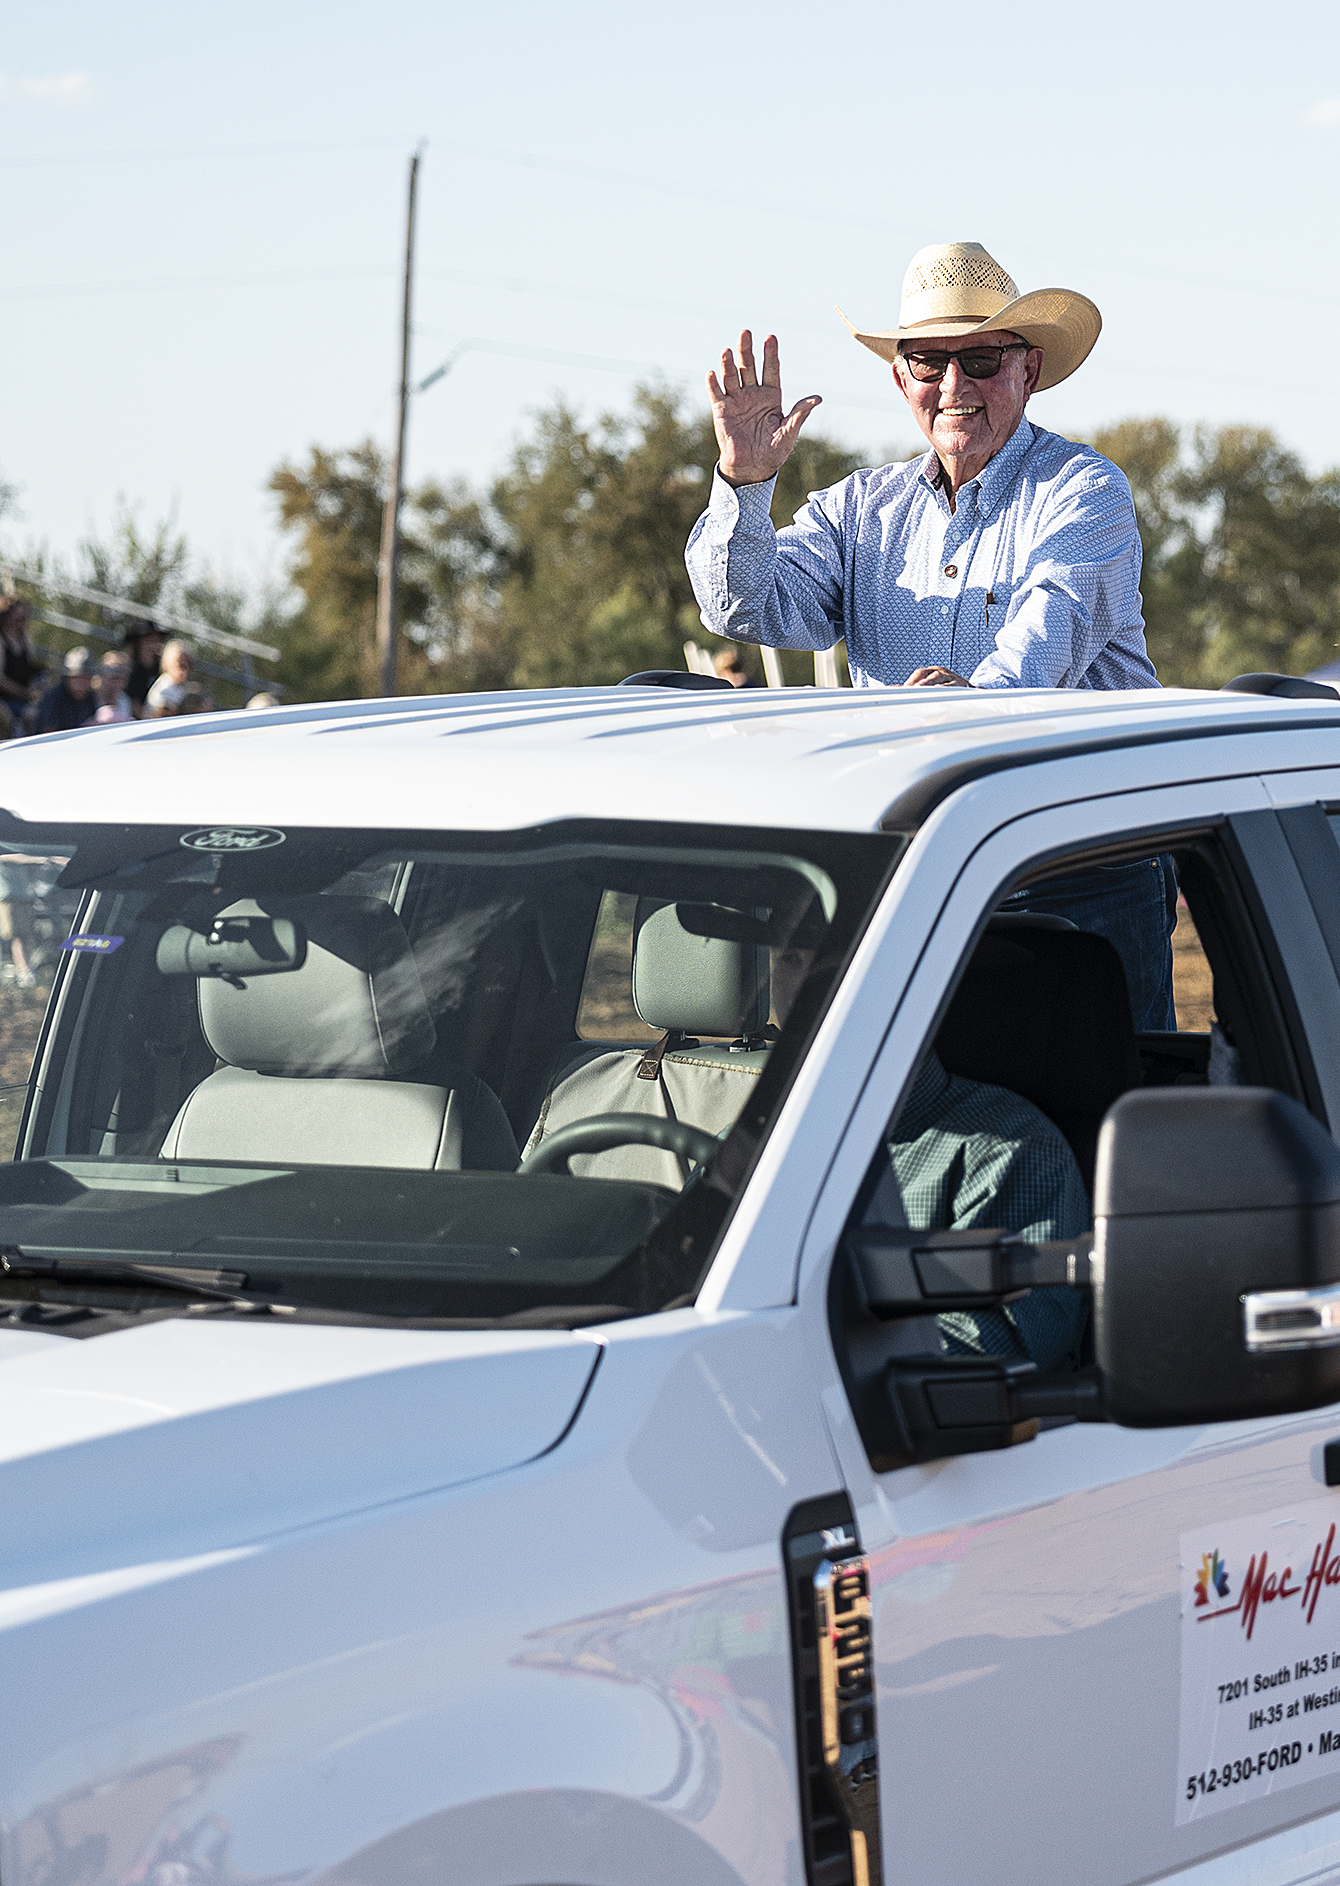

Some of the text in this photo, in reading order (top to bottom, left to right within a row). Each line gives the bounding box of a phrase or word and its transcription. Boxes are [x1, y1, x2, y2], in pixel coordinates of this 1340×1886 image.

[194, 828, 270, 848] Ford
[1197, 1551, 1301, 1640] Mac
[1217, 1677, 1248, 1704] 7201
[1254, 1666, 1291, 1695] South
[1295, 1654, 1328, 1680] IH-35
[1248, 1703, 1283, 1731] IH-35
[1286, 1700, 1300, 1719] at
[1186, 1740, 1302, 1800] 512-930-FORD
